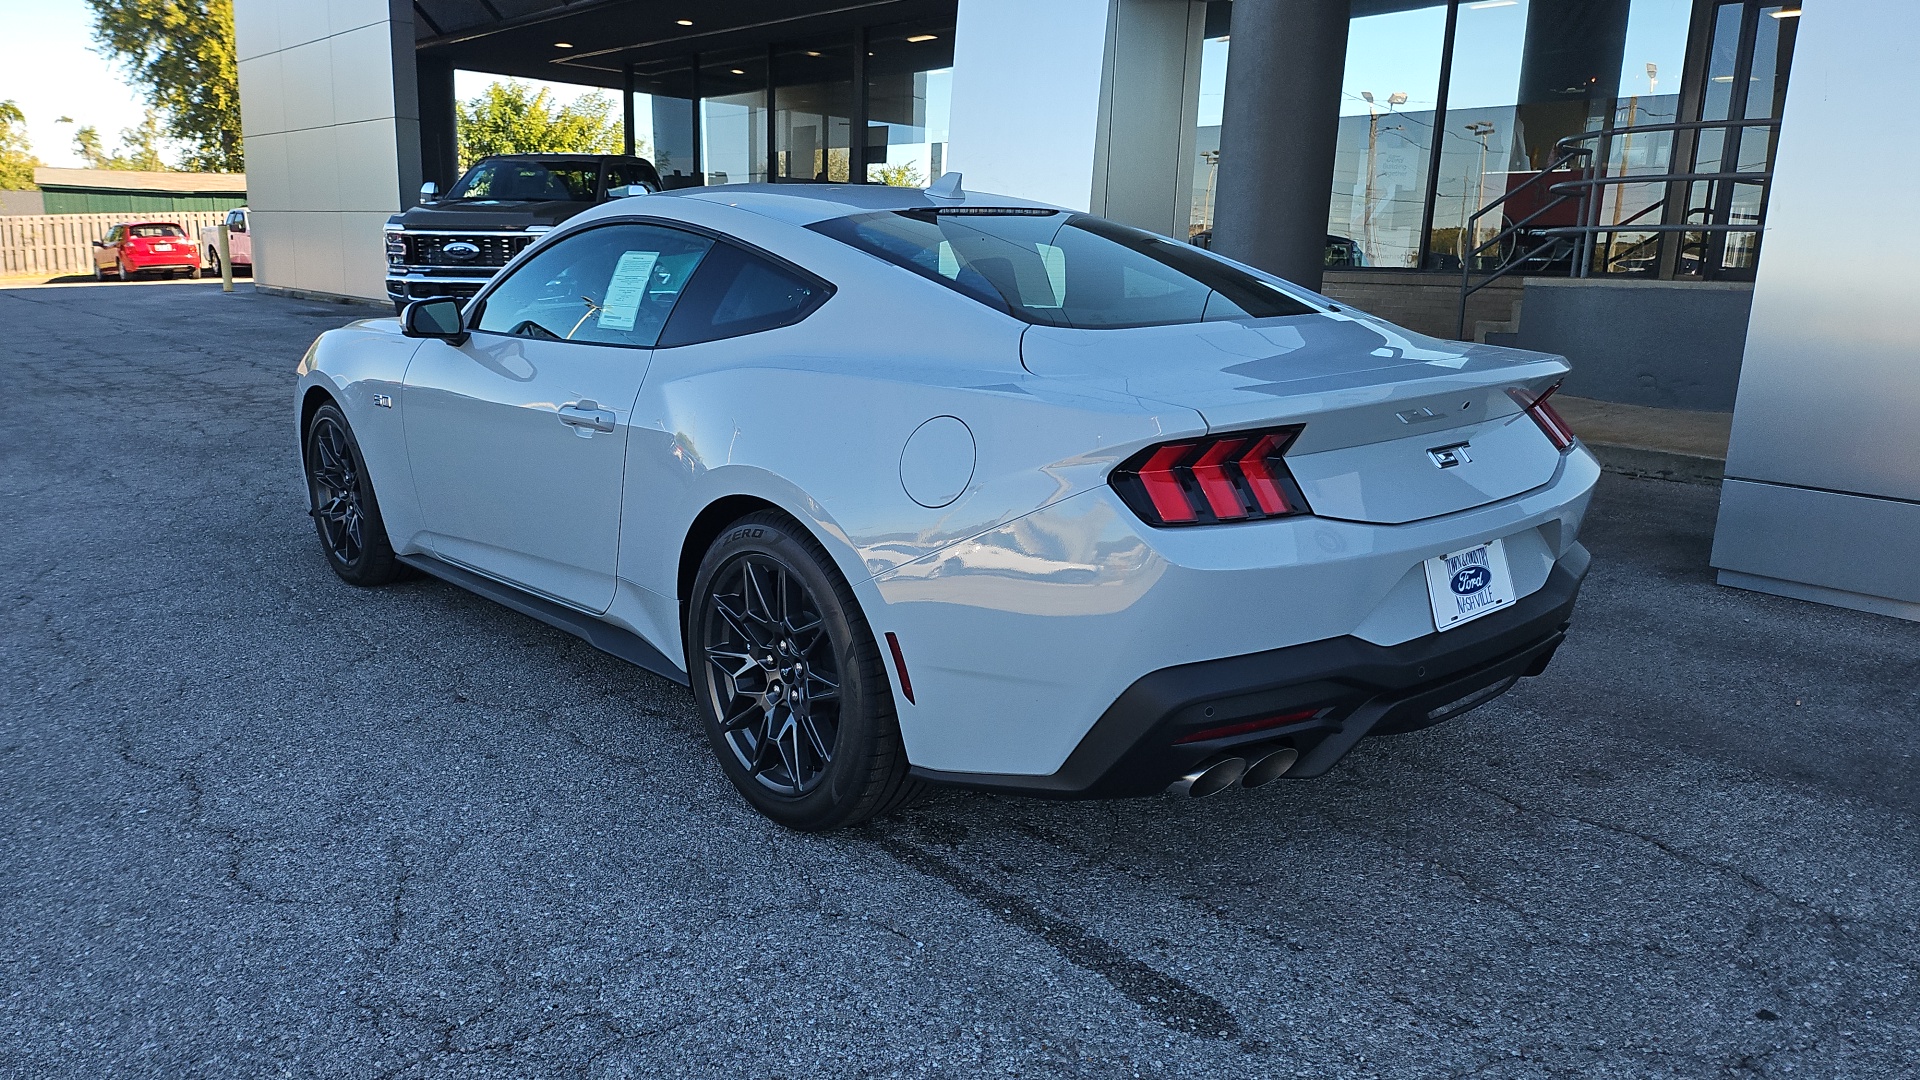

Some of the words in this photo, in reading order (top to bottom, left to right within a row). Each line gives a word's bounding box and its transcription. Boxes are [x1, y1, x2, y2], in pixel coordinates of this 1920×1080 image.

[1425, 440, 1473, 470] GT
[722, 528, 765, 547] ZERO
[1458, 569, 1484, 592] Ford
[1455, 585, 1495, 614] NASHVILLE
